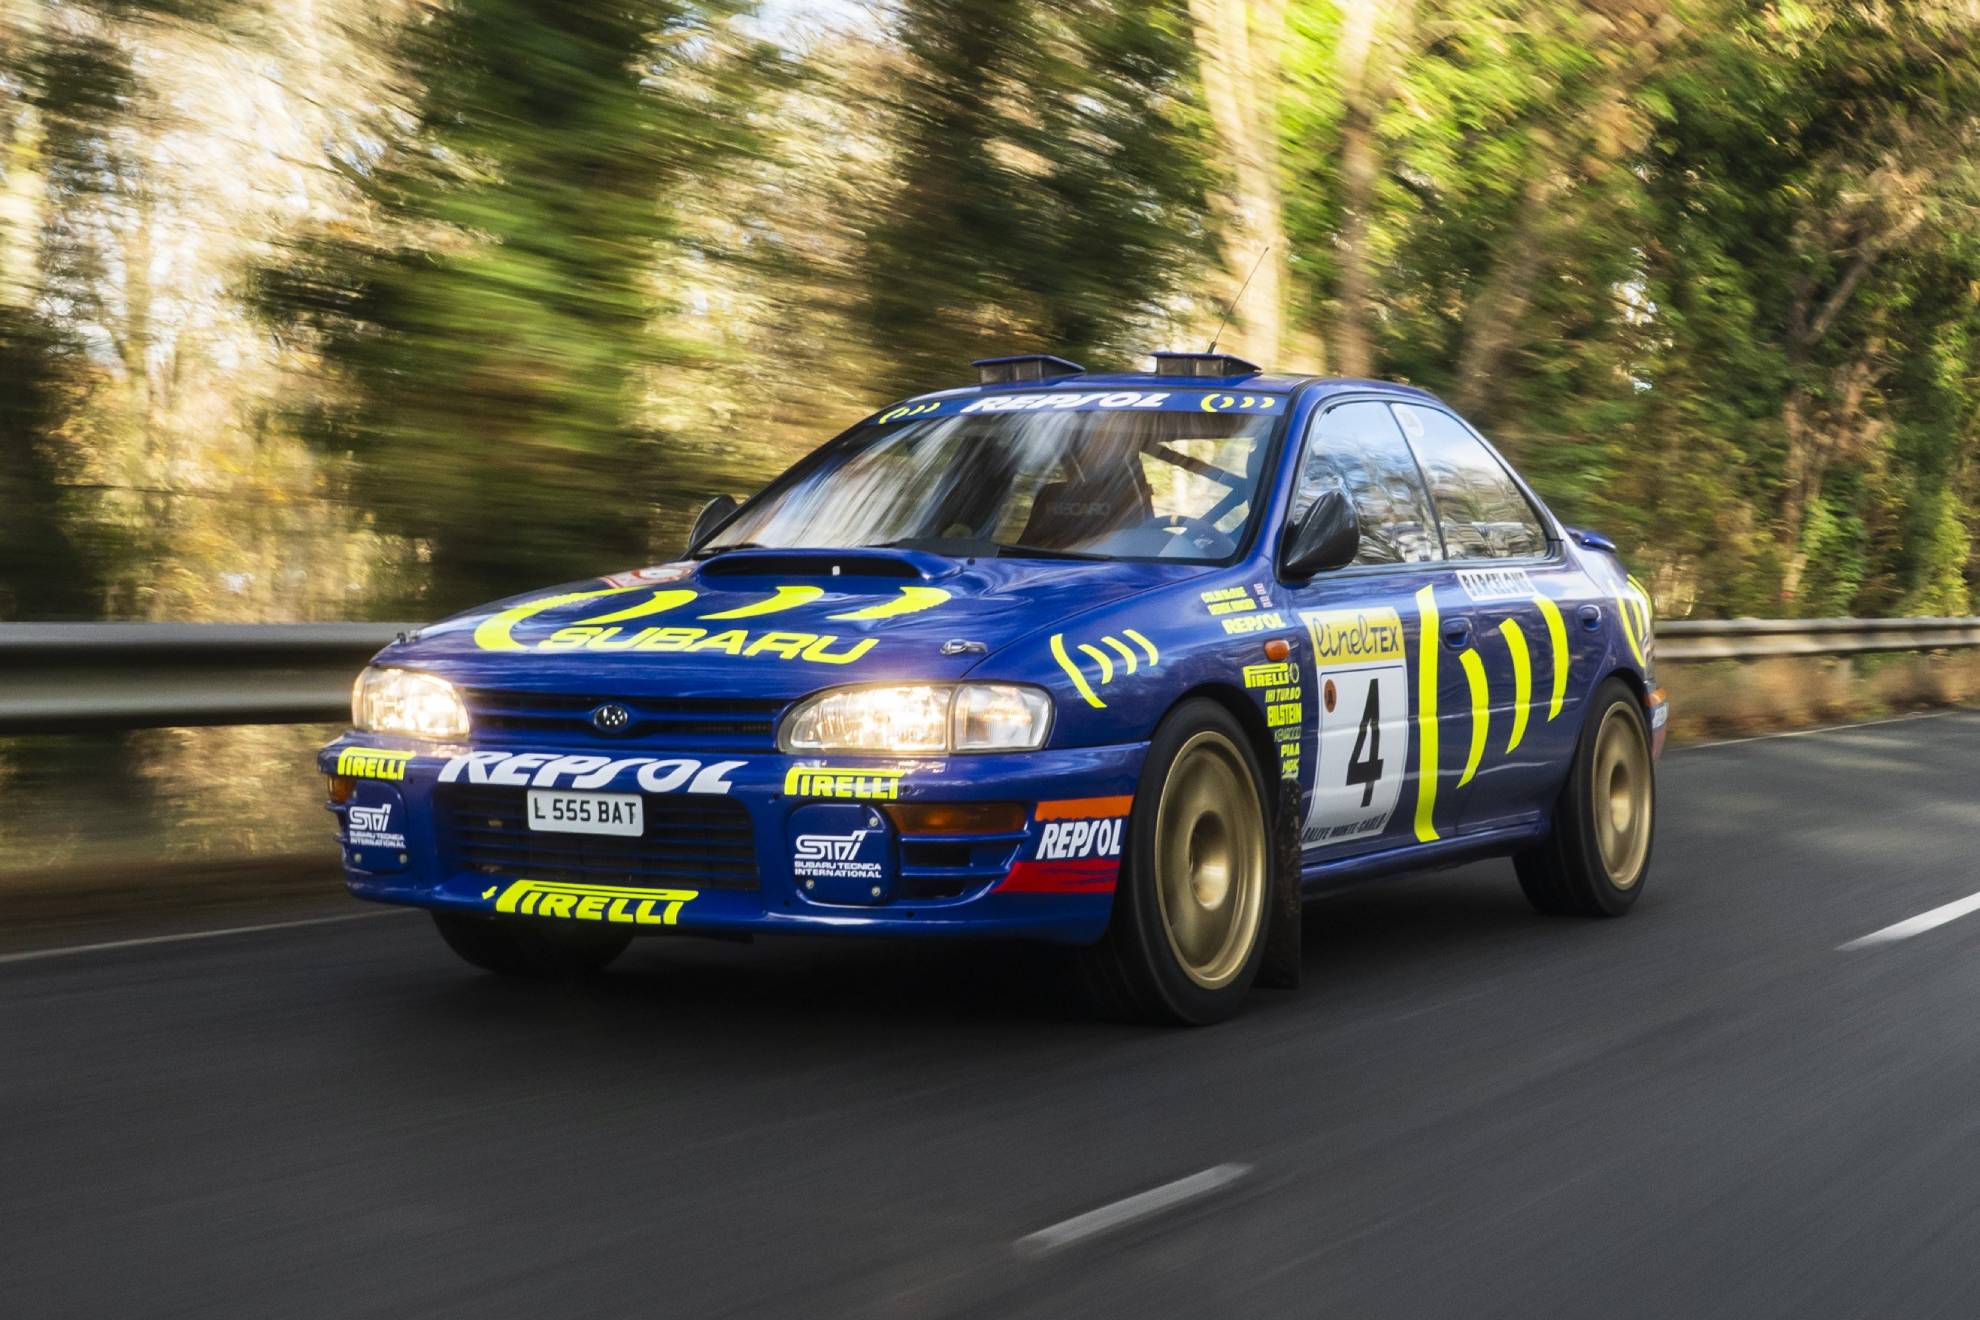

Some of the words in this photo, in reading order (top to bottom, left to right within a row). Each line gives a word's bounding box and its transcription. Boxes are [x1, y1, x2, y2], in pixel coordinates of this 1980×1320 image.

[960, 391, 1171, 413] REPSOL
[1221, 612, 1287, 635] REPSOL
[538, 626, 880, 665] SUBARU
[1243, 662, 1289, 688] PIRELLI
[1346, 678, 1384, 808] 4
[337, 746, 416, 781] PIRELLI
[437, 751, 749, 795] REPSOL
[784, 766, 905, 800] PIRELLI
[534, 797, 546, 820] L
[552, 798, 592, 823] 555
[598, 801, 637, 826] BAT
[349, 831, 375, 840] SUBARU
[375, 832, 405, 842] TECNICA
[349, 838, 406, 849] INTERNATIONAL
[1035, 818, 1122, 860] REPSOL
[794, 860, 837, 870] SUBARU
[838, 862, 882, 872] TECNICA
[794, 868, 882, 879] INTERNATIONAL
[496, 879, 699, 926] PIRELLI
